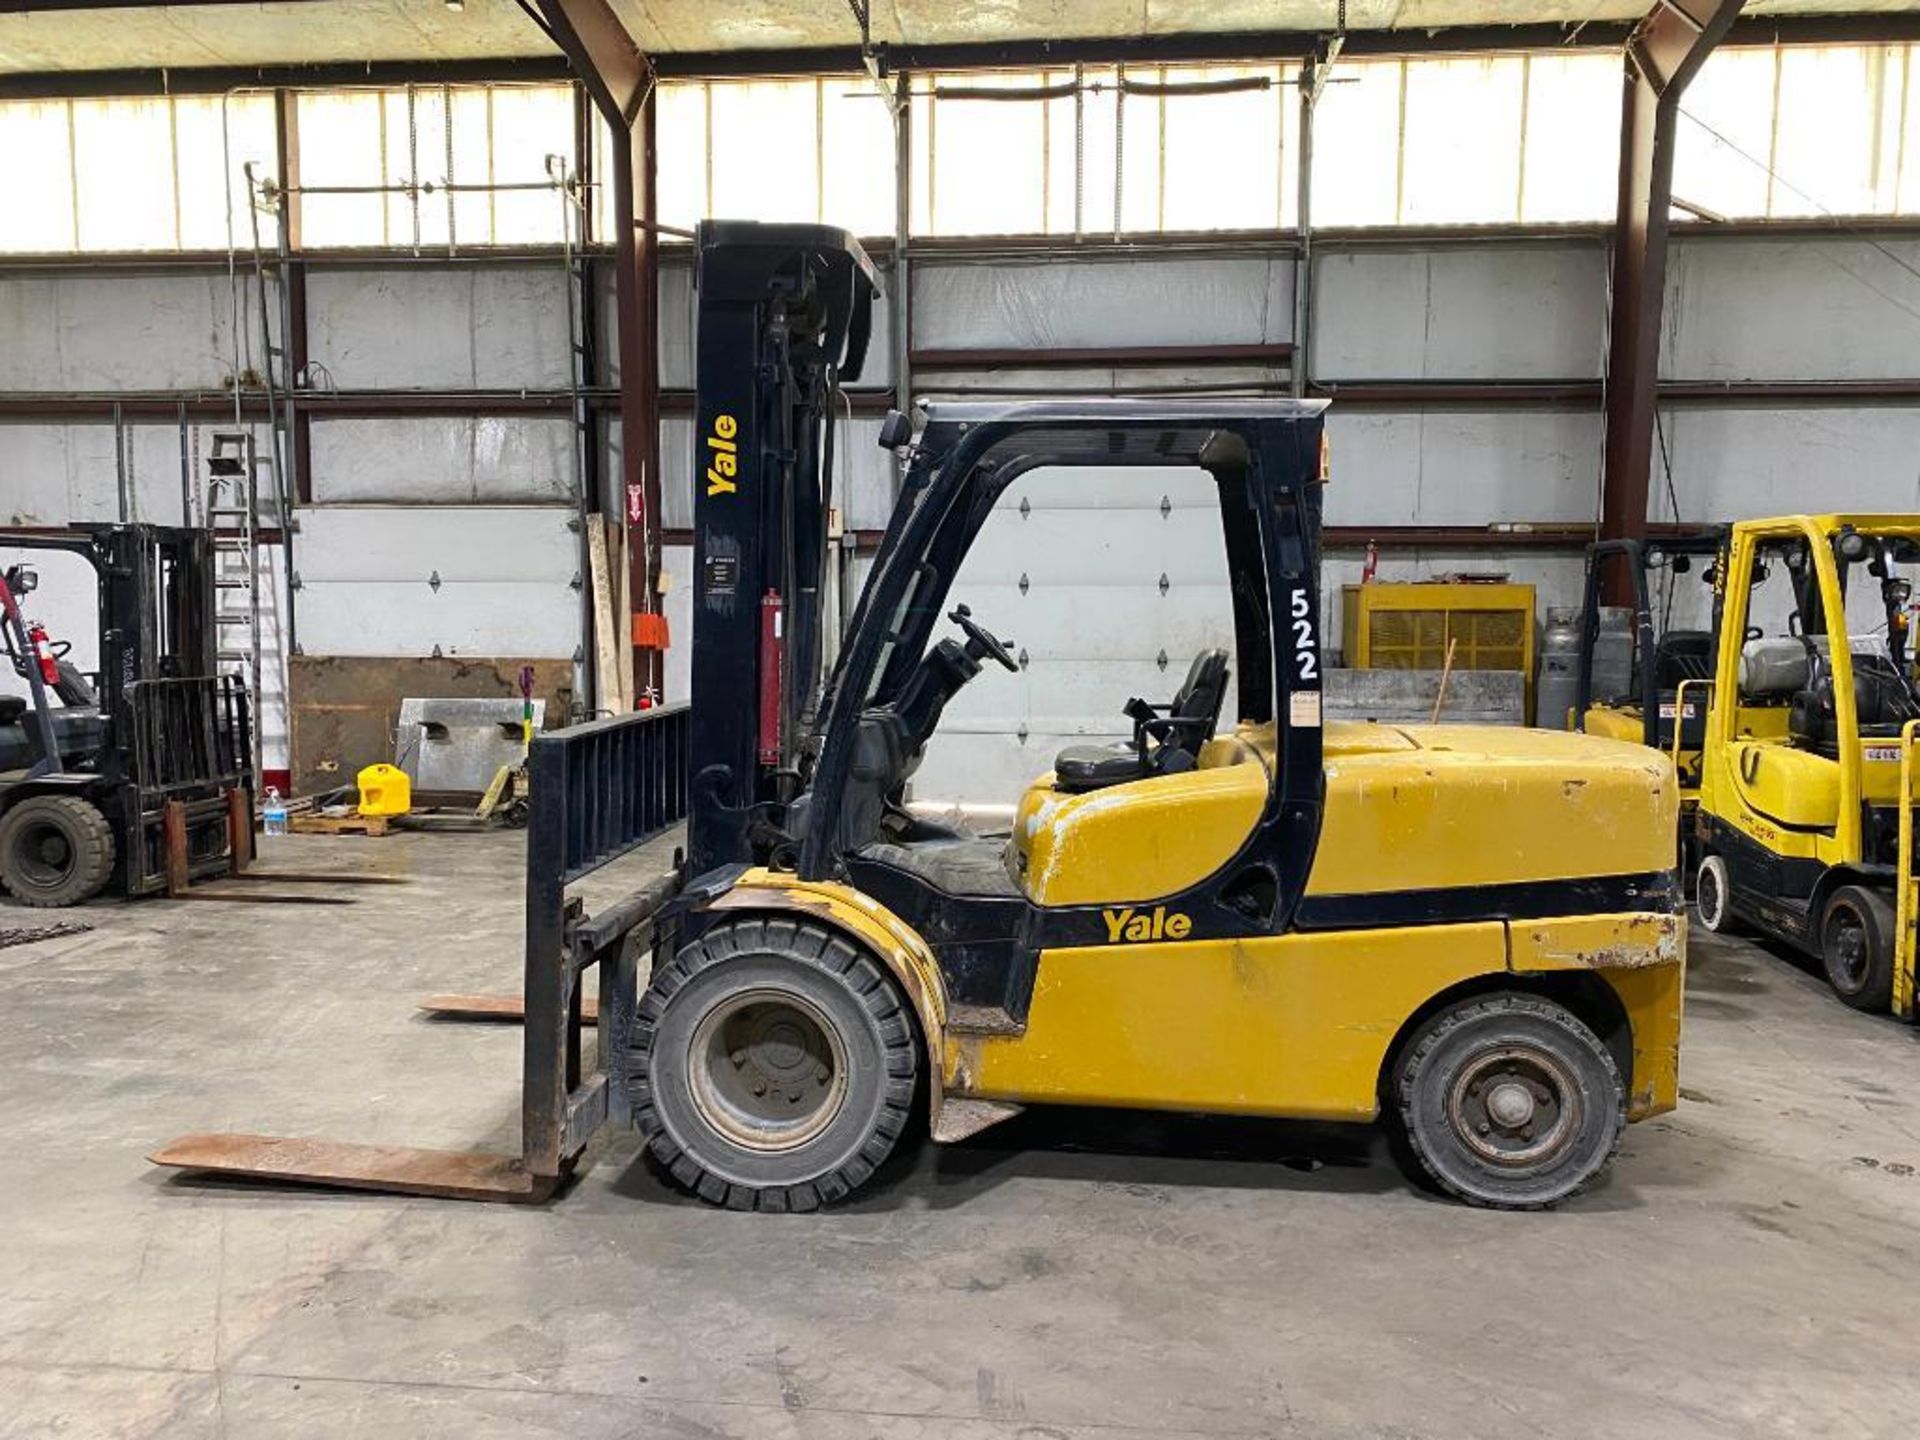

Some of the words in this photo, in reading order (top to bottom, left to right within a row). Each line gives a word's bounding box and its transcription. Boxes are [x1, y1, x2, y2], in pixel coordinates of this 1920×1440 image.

[707, 414, 737, 497] Yale
[1291, 588, 1318, 680] 522
[1102, 905, 1192, 942] Yale
